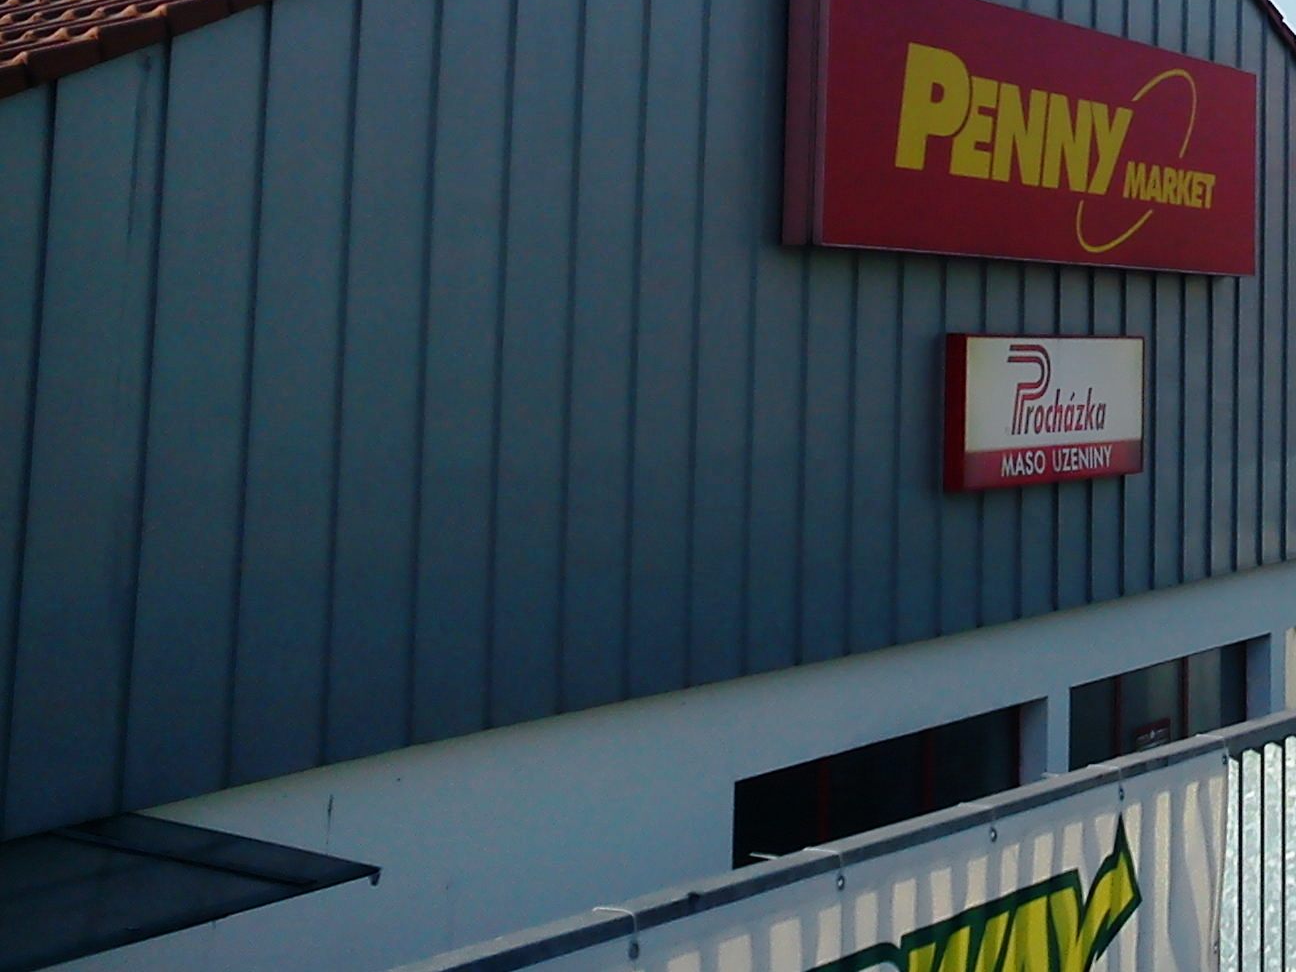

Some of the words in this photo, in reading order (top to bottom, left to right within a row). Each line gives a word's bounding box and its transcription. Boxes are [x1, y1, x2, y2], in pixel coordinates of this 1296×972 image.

[895, 42, 1133, 195] PENNY
[1123, 160, 1216, 209] MARKET
[1007, 344, 1107, 435] Procházka
[1001, 450, 1046, 477] MASO
[1052, 445, 1113, 472] UZENINY
